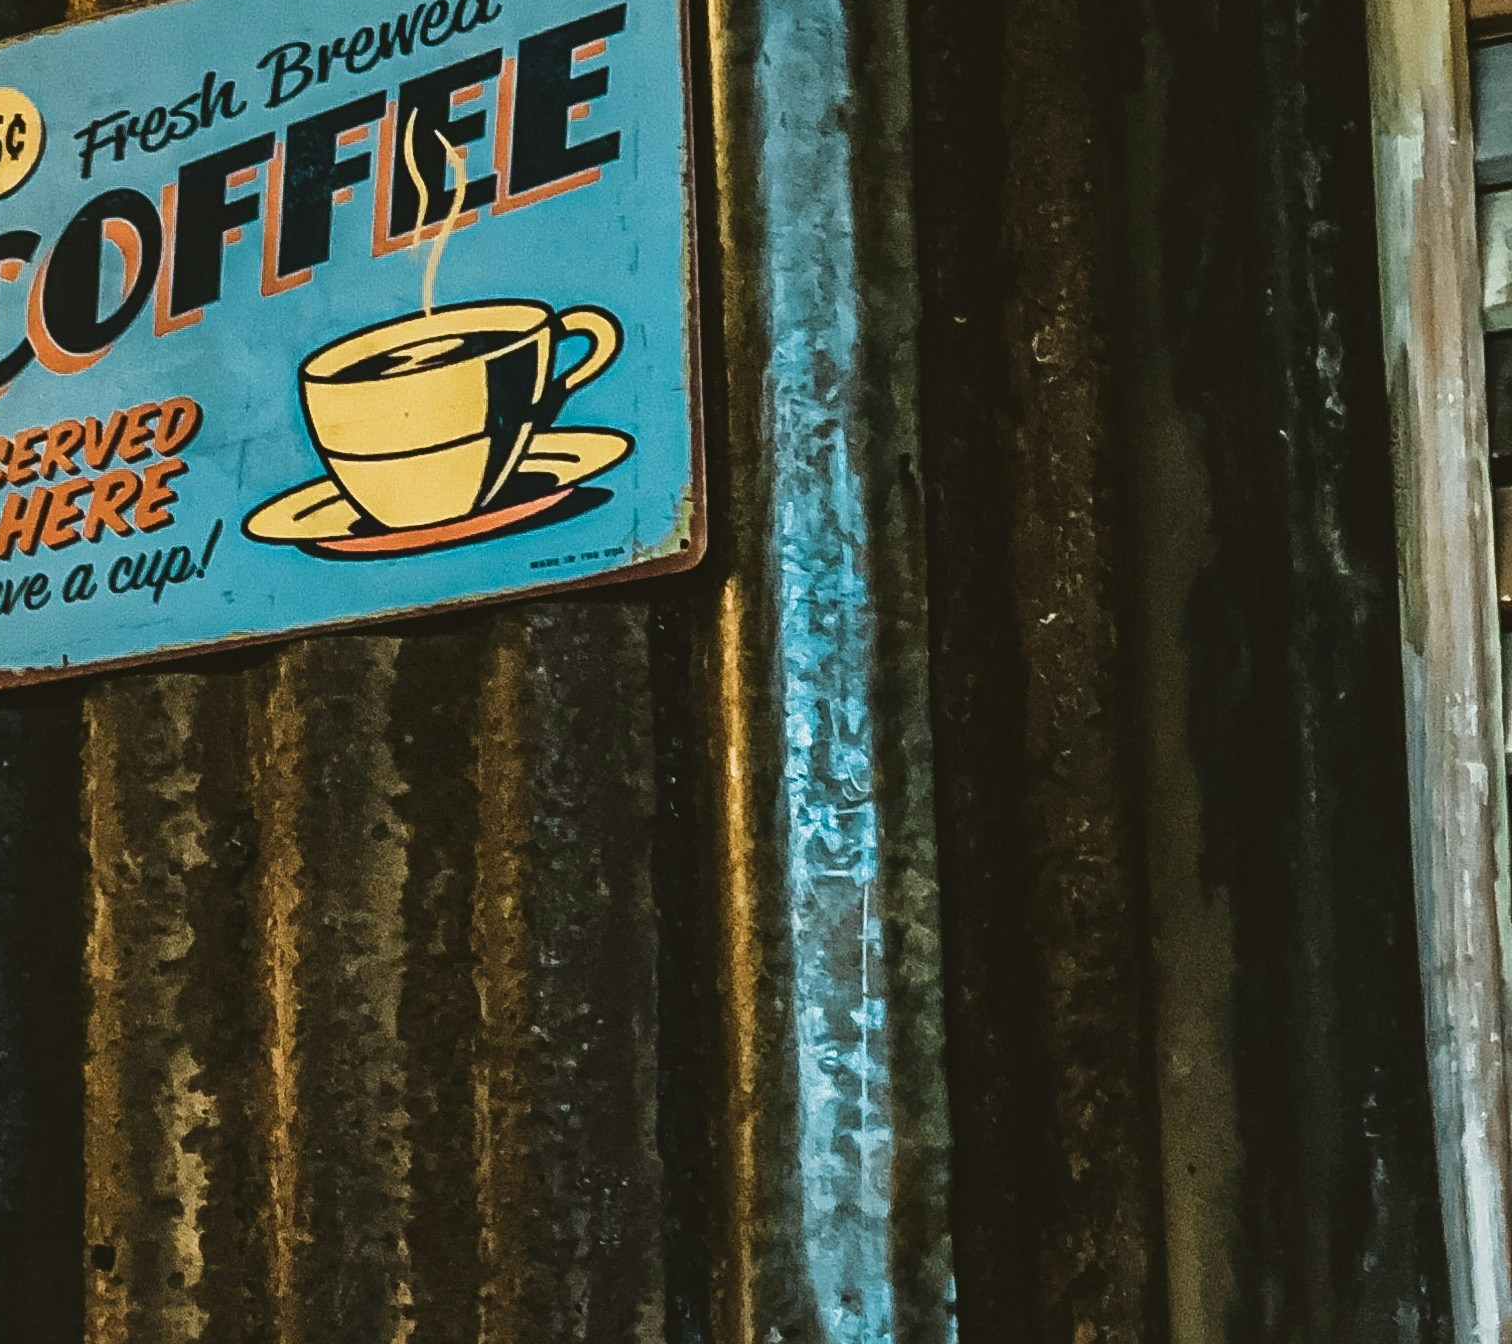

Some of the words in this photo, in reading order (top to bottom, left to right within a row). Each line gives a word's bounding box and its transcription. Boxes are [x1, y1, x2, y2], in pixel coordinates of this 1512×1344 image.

[75, 69, 248, 179] Fresh
[62, 570, 98, 604] a
[108, 520, 224, 604] cup!
